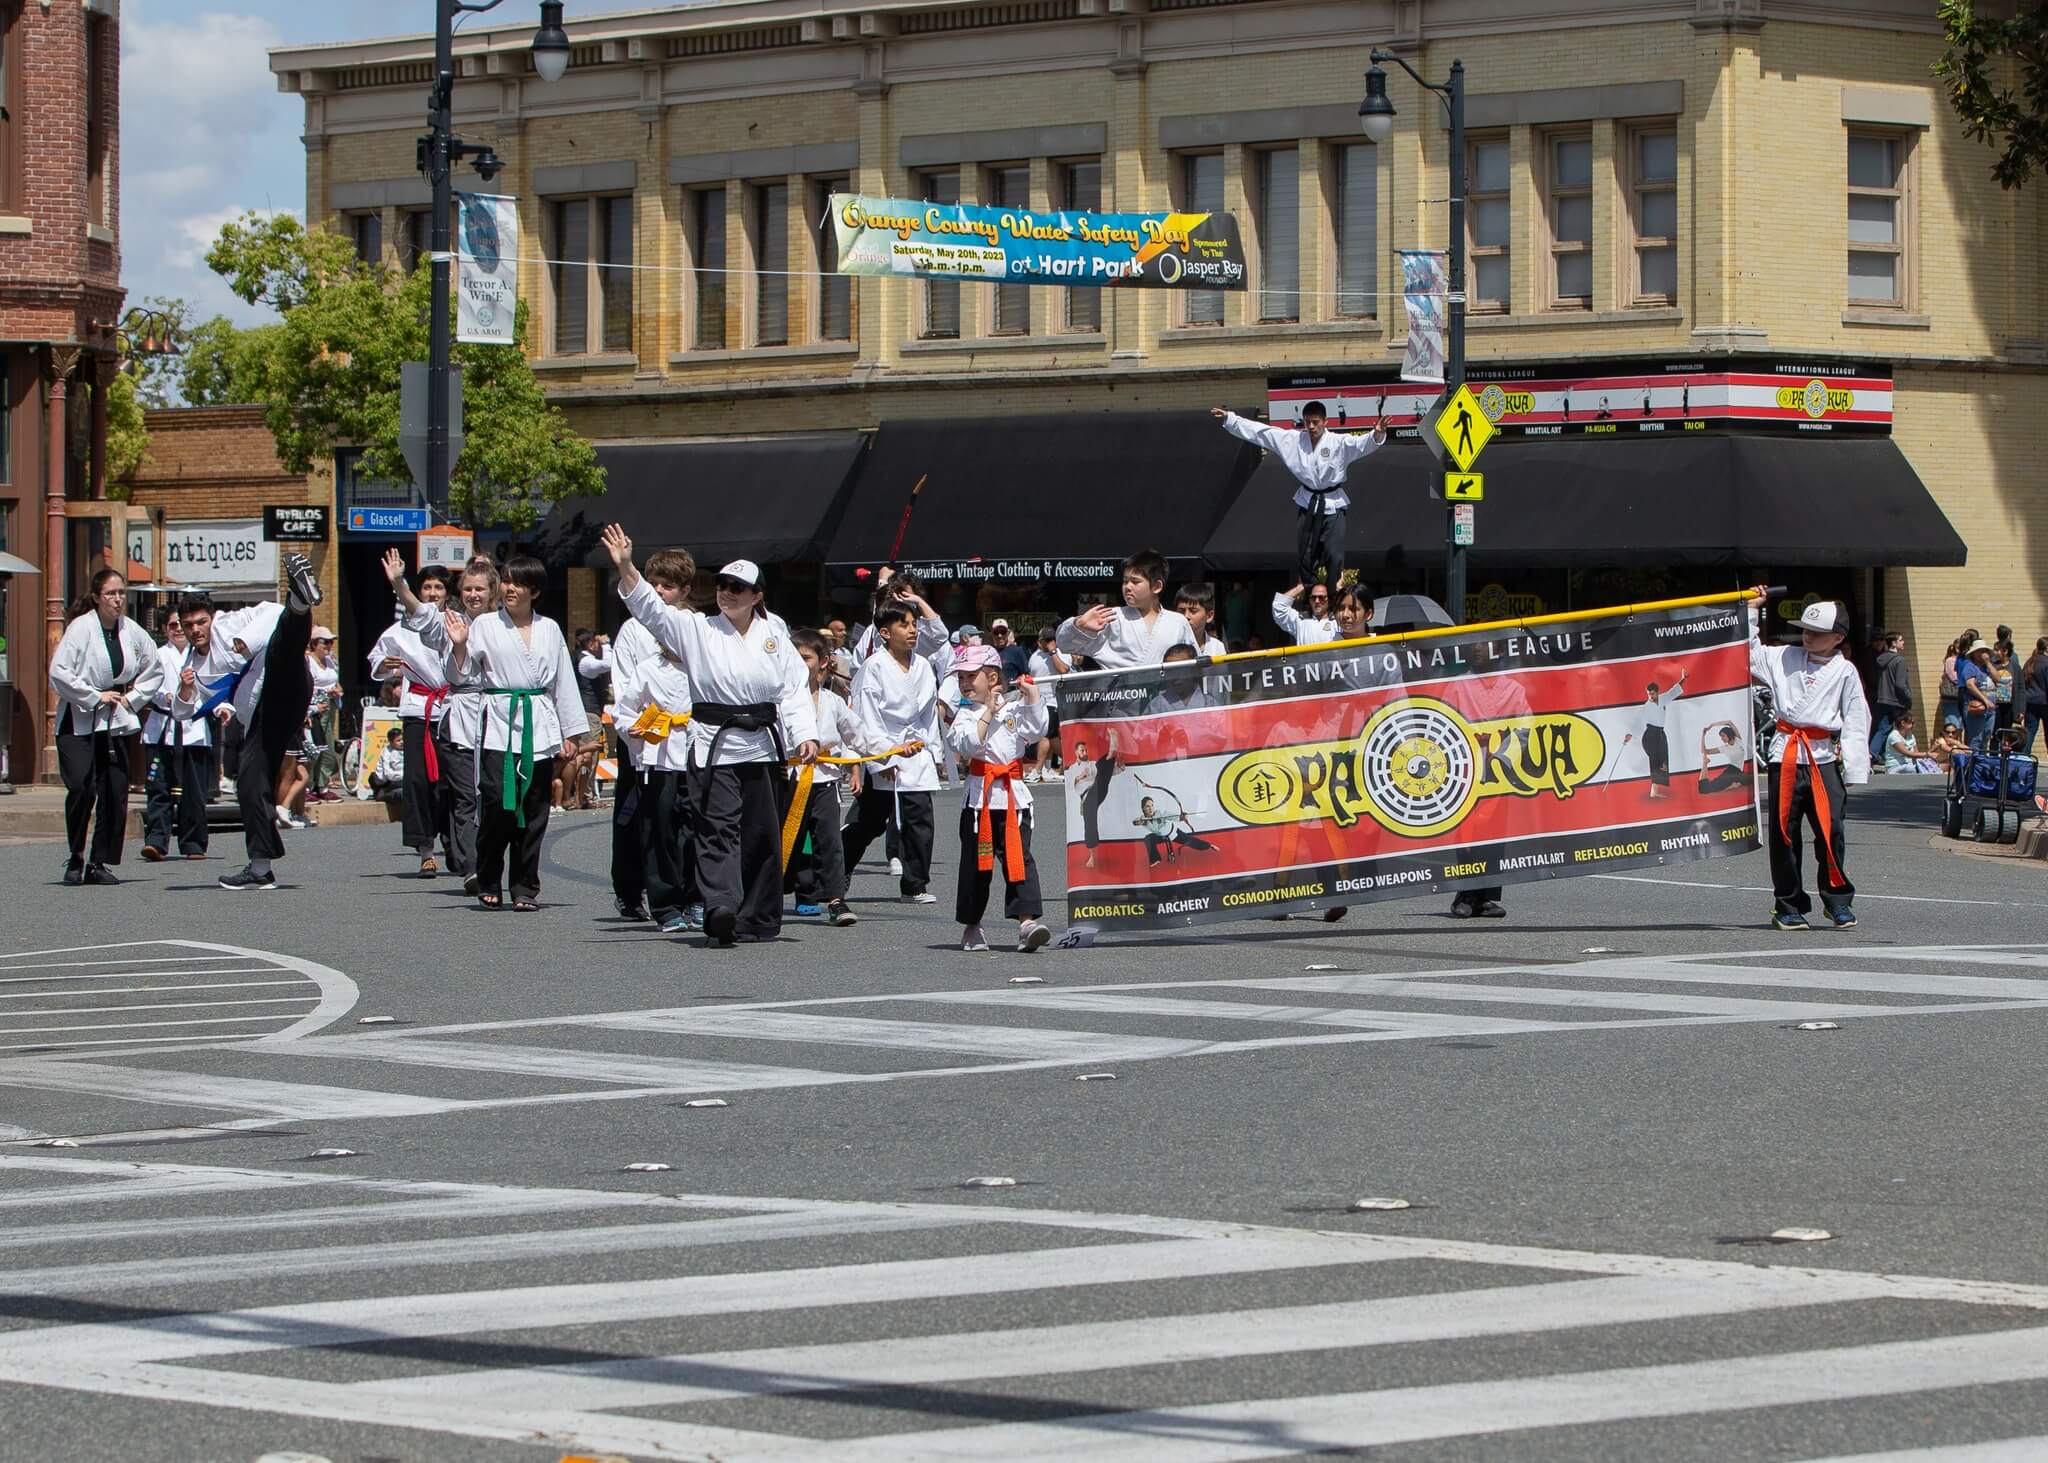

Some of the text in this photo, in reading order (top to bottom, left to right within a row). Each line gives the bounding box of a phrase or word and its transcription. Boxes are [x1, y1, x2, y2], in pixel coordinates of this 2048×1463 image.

[842, 200, 1190, 254] Orange County Water Safety Day
[893, 244, 935, 258] Saturday,
[936, 247, 955, 260] May
[957, 248, 980, 261] 20th,
[982, 250, 1004, 261] 2023
[1011, 254, 1145, 278] at Hart Park
[1181, 258, 1243, 280] Jasper Ray
[461, 276, 512, 290] Trevor A.
[481, 328, 503, 336] ARMY
[1775, 364, 1856, 376] INTERNATIONAL LEAGUE
[1505, 394, 1530, 415] KUA
[1791, 390, 1805, 409] PA
[1827, 391, 1849, 411] KUA
[1639, 422, 1665, 431] RHYTHM
[1683, 421, 1705, 430] TAI CHI
[282, 521, 316, 533] CAFE
[370, 512, 404, 526] Glassell
[168, 536, 256, 569] ntiques
[956, 562, 995, 581] Vintage
[996, 561, 1040, 580] Clothing
[1043, 561, 1052, 577] &
[1055, 561, 1114, 577] Accessories
[1653, 615, 1740, 639] WWW.PAKUA.COM
[1202, 631, 1594, 695] INTERNATIONAL LEAGUE
[1064, 687, 1148, 704] WWW.PAKUA.COM
[1292, 749, 1363, 823] PA
[1473, 722, 1580, 796] KUA
[1073, 904, 1146, 919] ACROBATICS
[1156, 897, 1210, 915] ARCHERY
[1222, 882, 1325, 907] COSMODYNAMICS
[1335, 876, 1374, 892] EDGED
[1374, 868, 1433, 888] WEAPONS
[1443, 861, 1488, 878] ENERGY
[1499, 854, 1550, 872] MARTIAL
[1550, 851, 1566, 865] ART
[1573, 841, 1649, 862] REFLEXOLOGY
[1660, 833, 1711, 851] RHYTHM
